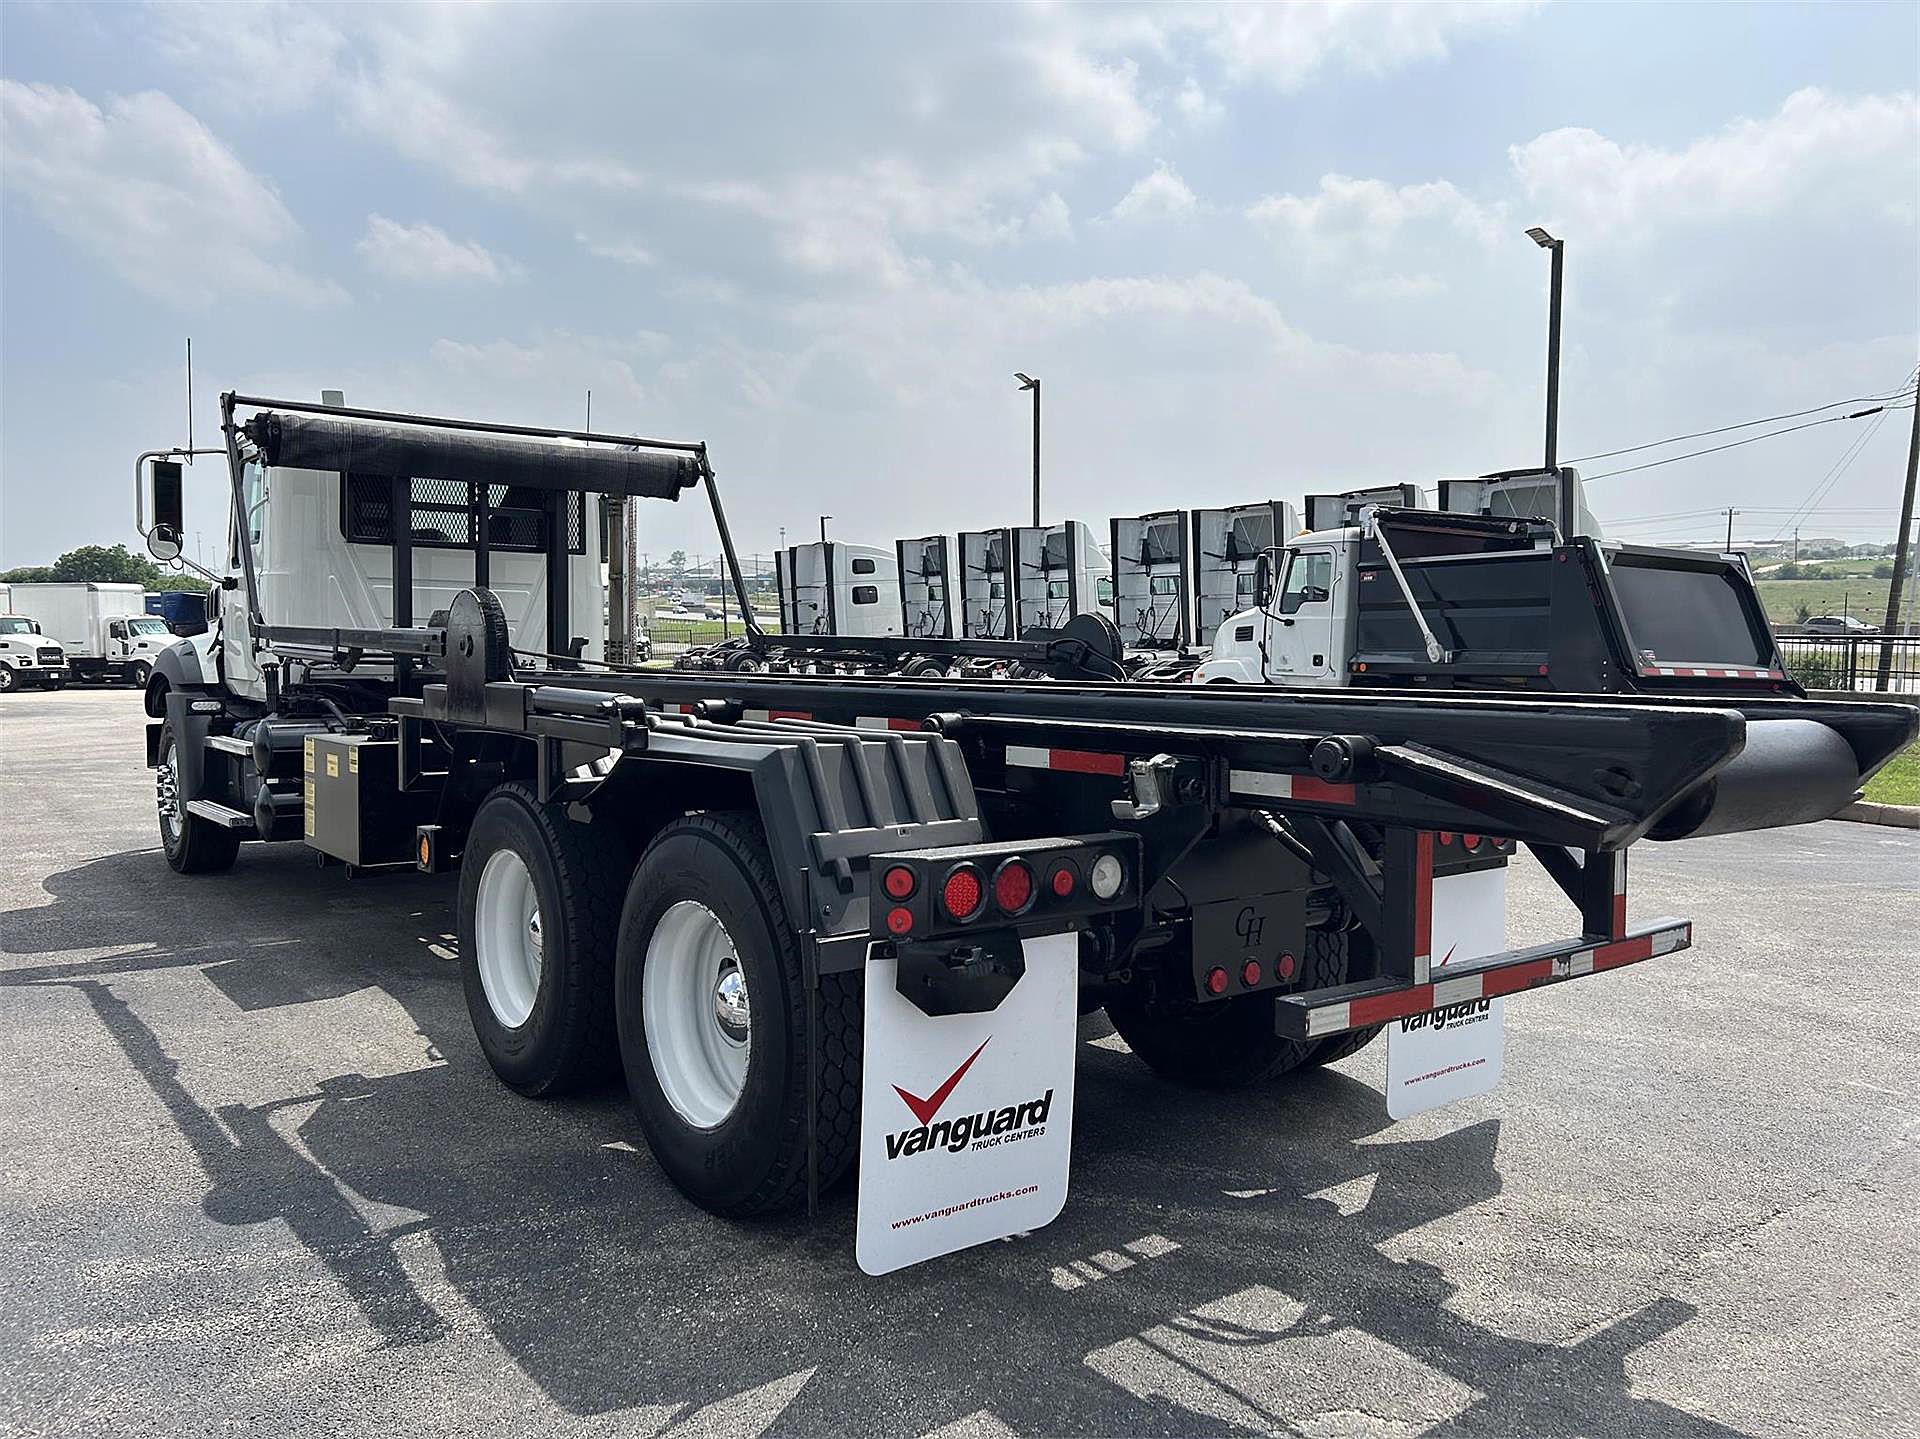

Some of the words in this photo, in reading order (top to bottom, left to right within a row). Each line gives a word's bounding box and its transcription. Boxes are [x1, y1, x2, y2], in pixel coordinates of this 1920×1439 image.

[1446, 1020, 1464, 1030] TRUCK
[1464, 1013, 1489, 1026] CENTERS
[1404, 1058, 1486, 1086] www.vanguardtrucks.com
[885, 1089, 1054, 1160] vanguard
[971, 1135, 1003, 1151] TRUCK
[1004, 1126, 1046, 1144] CENTERS
[891, 1184, 1039, 1230] www.vanguardtrucks.com
